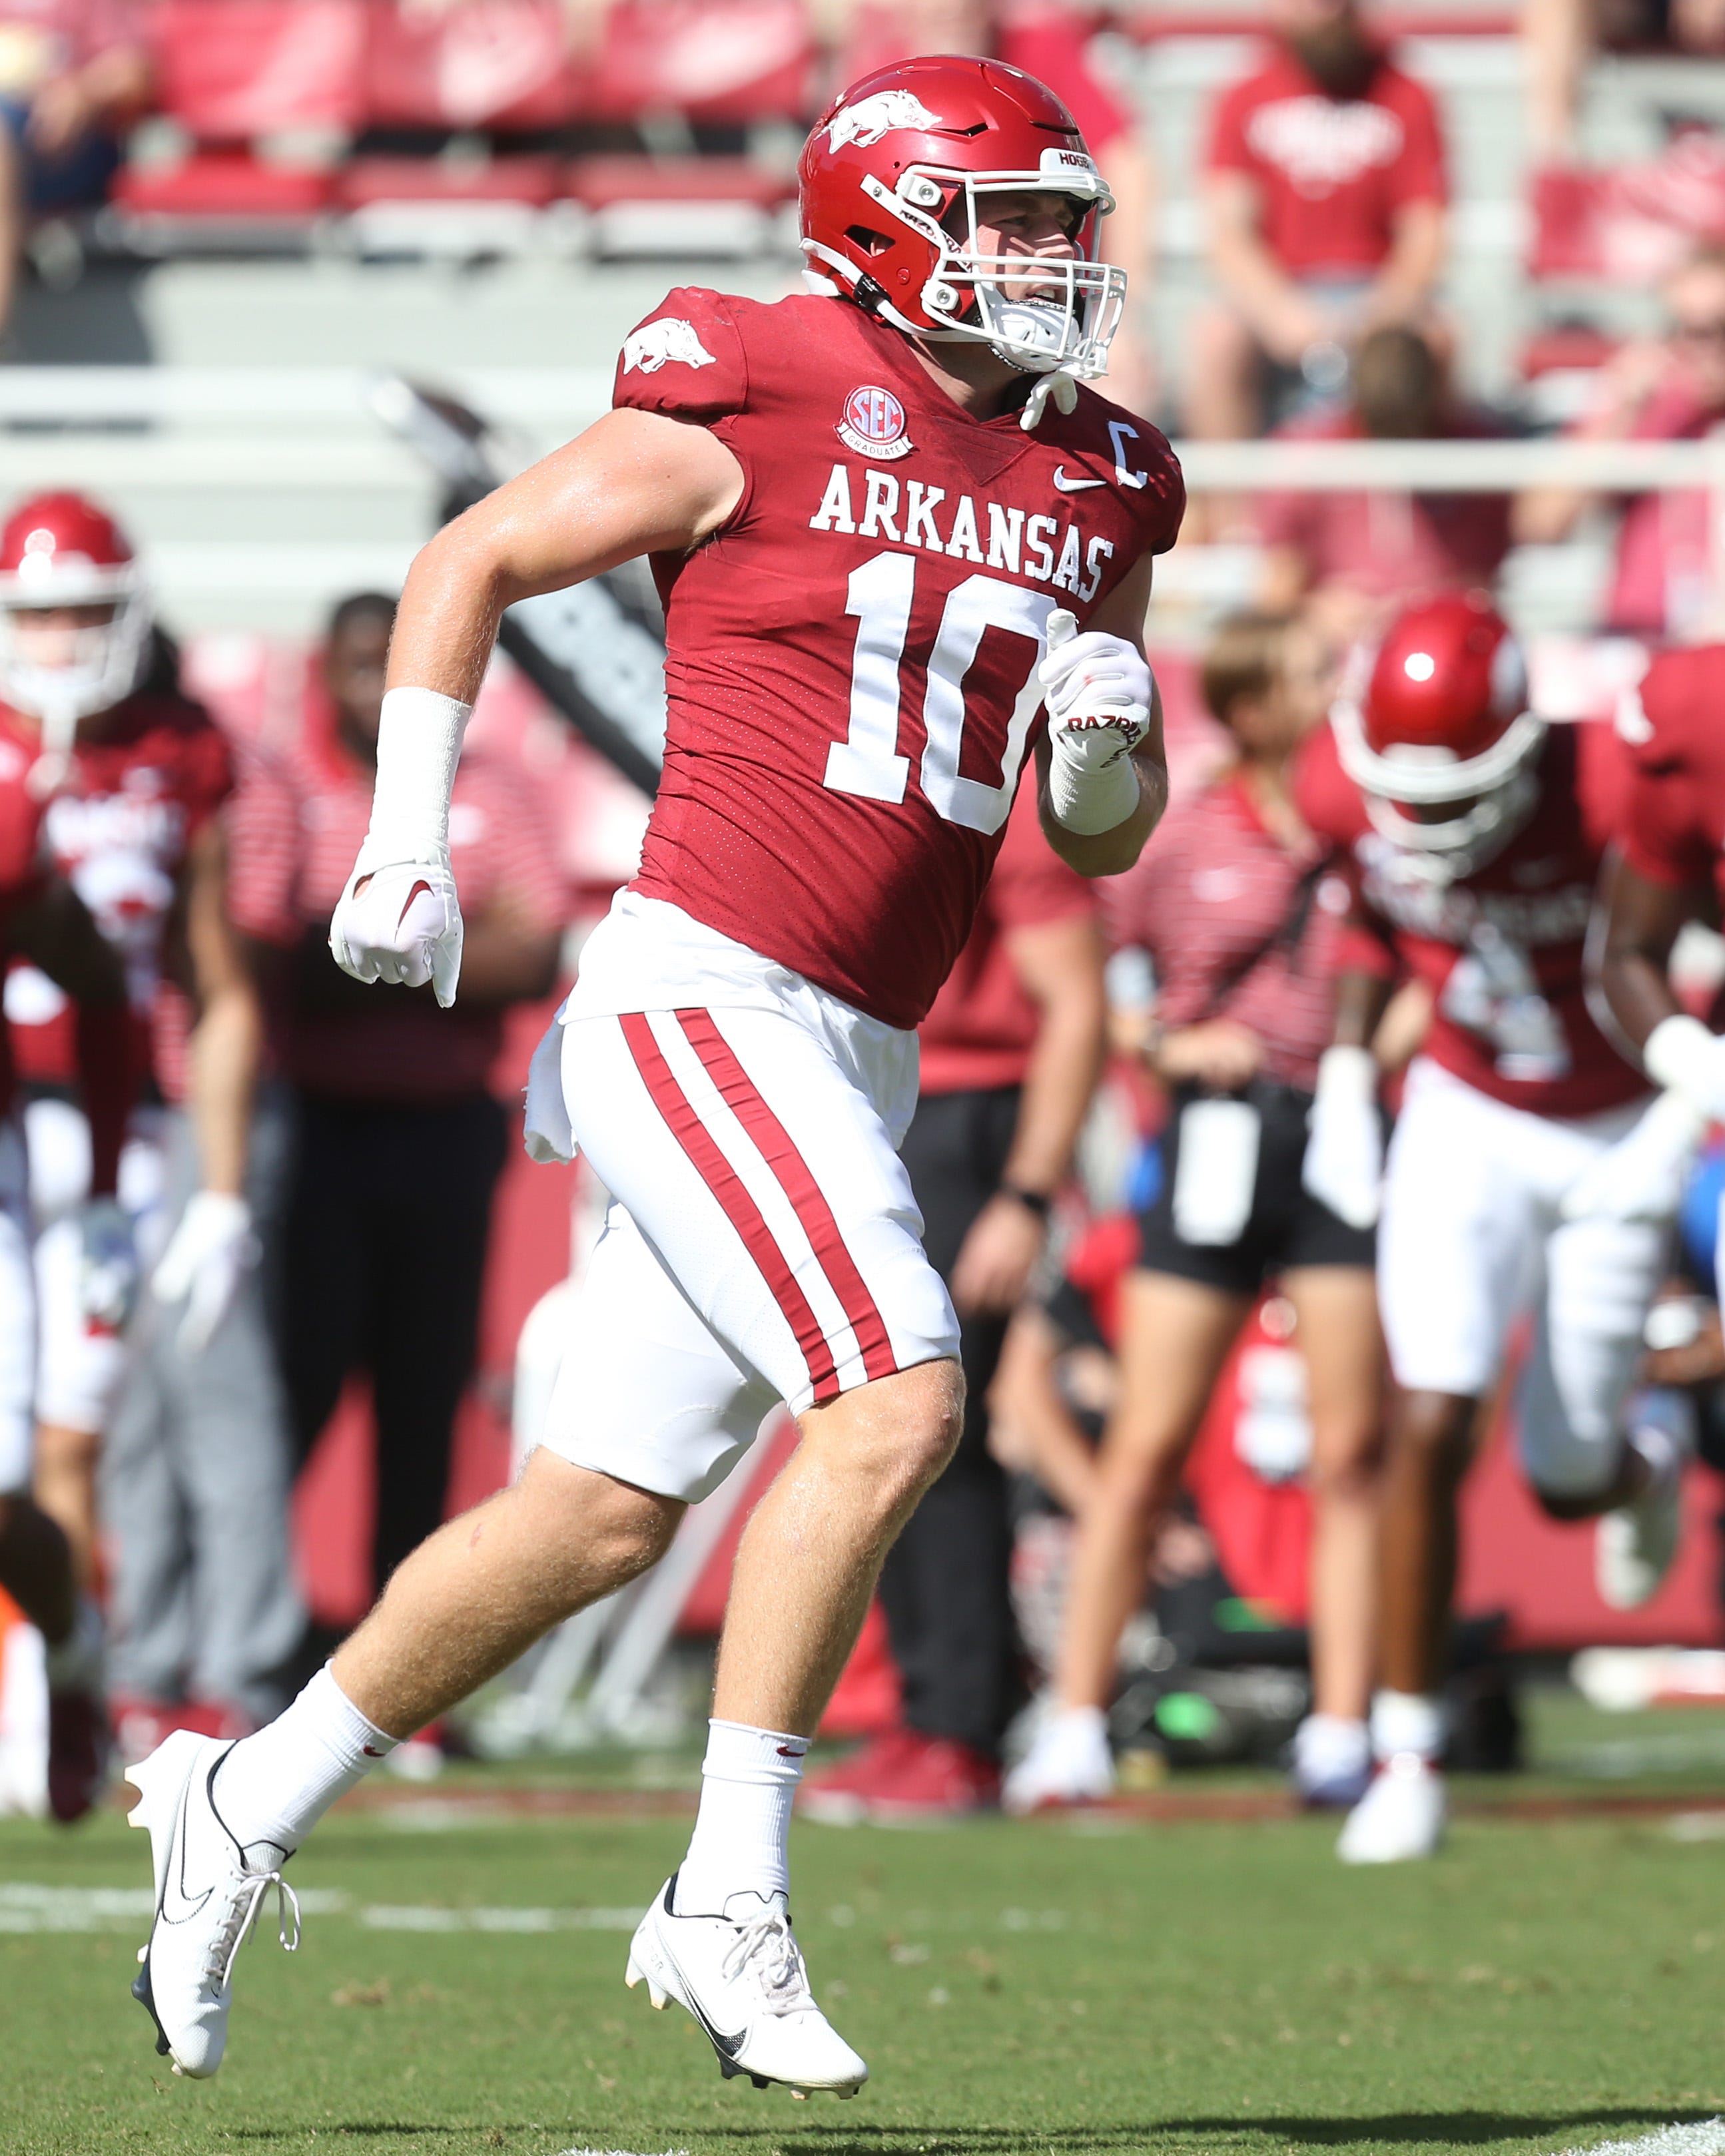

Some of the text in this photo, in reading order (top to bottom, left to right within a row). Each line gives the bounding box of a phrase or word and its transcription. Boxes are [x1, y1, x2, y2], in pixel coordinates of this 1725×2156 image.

[848, 435, 902, 456] GRADUATE
[853, 390, 900, 439] SEC
[1108, 420, 1149, 489] C
[809, 463, 1114, 603] ARKANSAS
[823, 551, 1060, 836] 10
